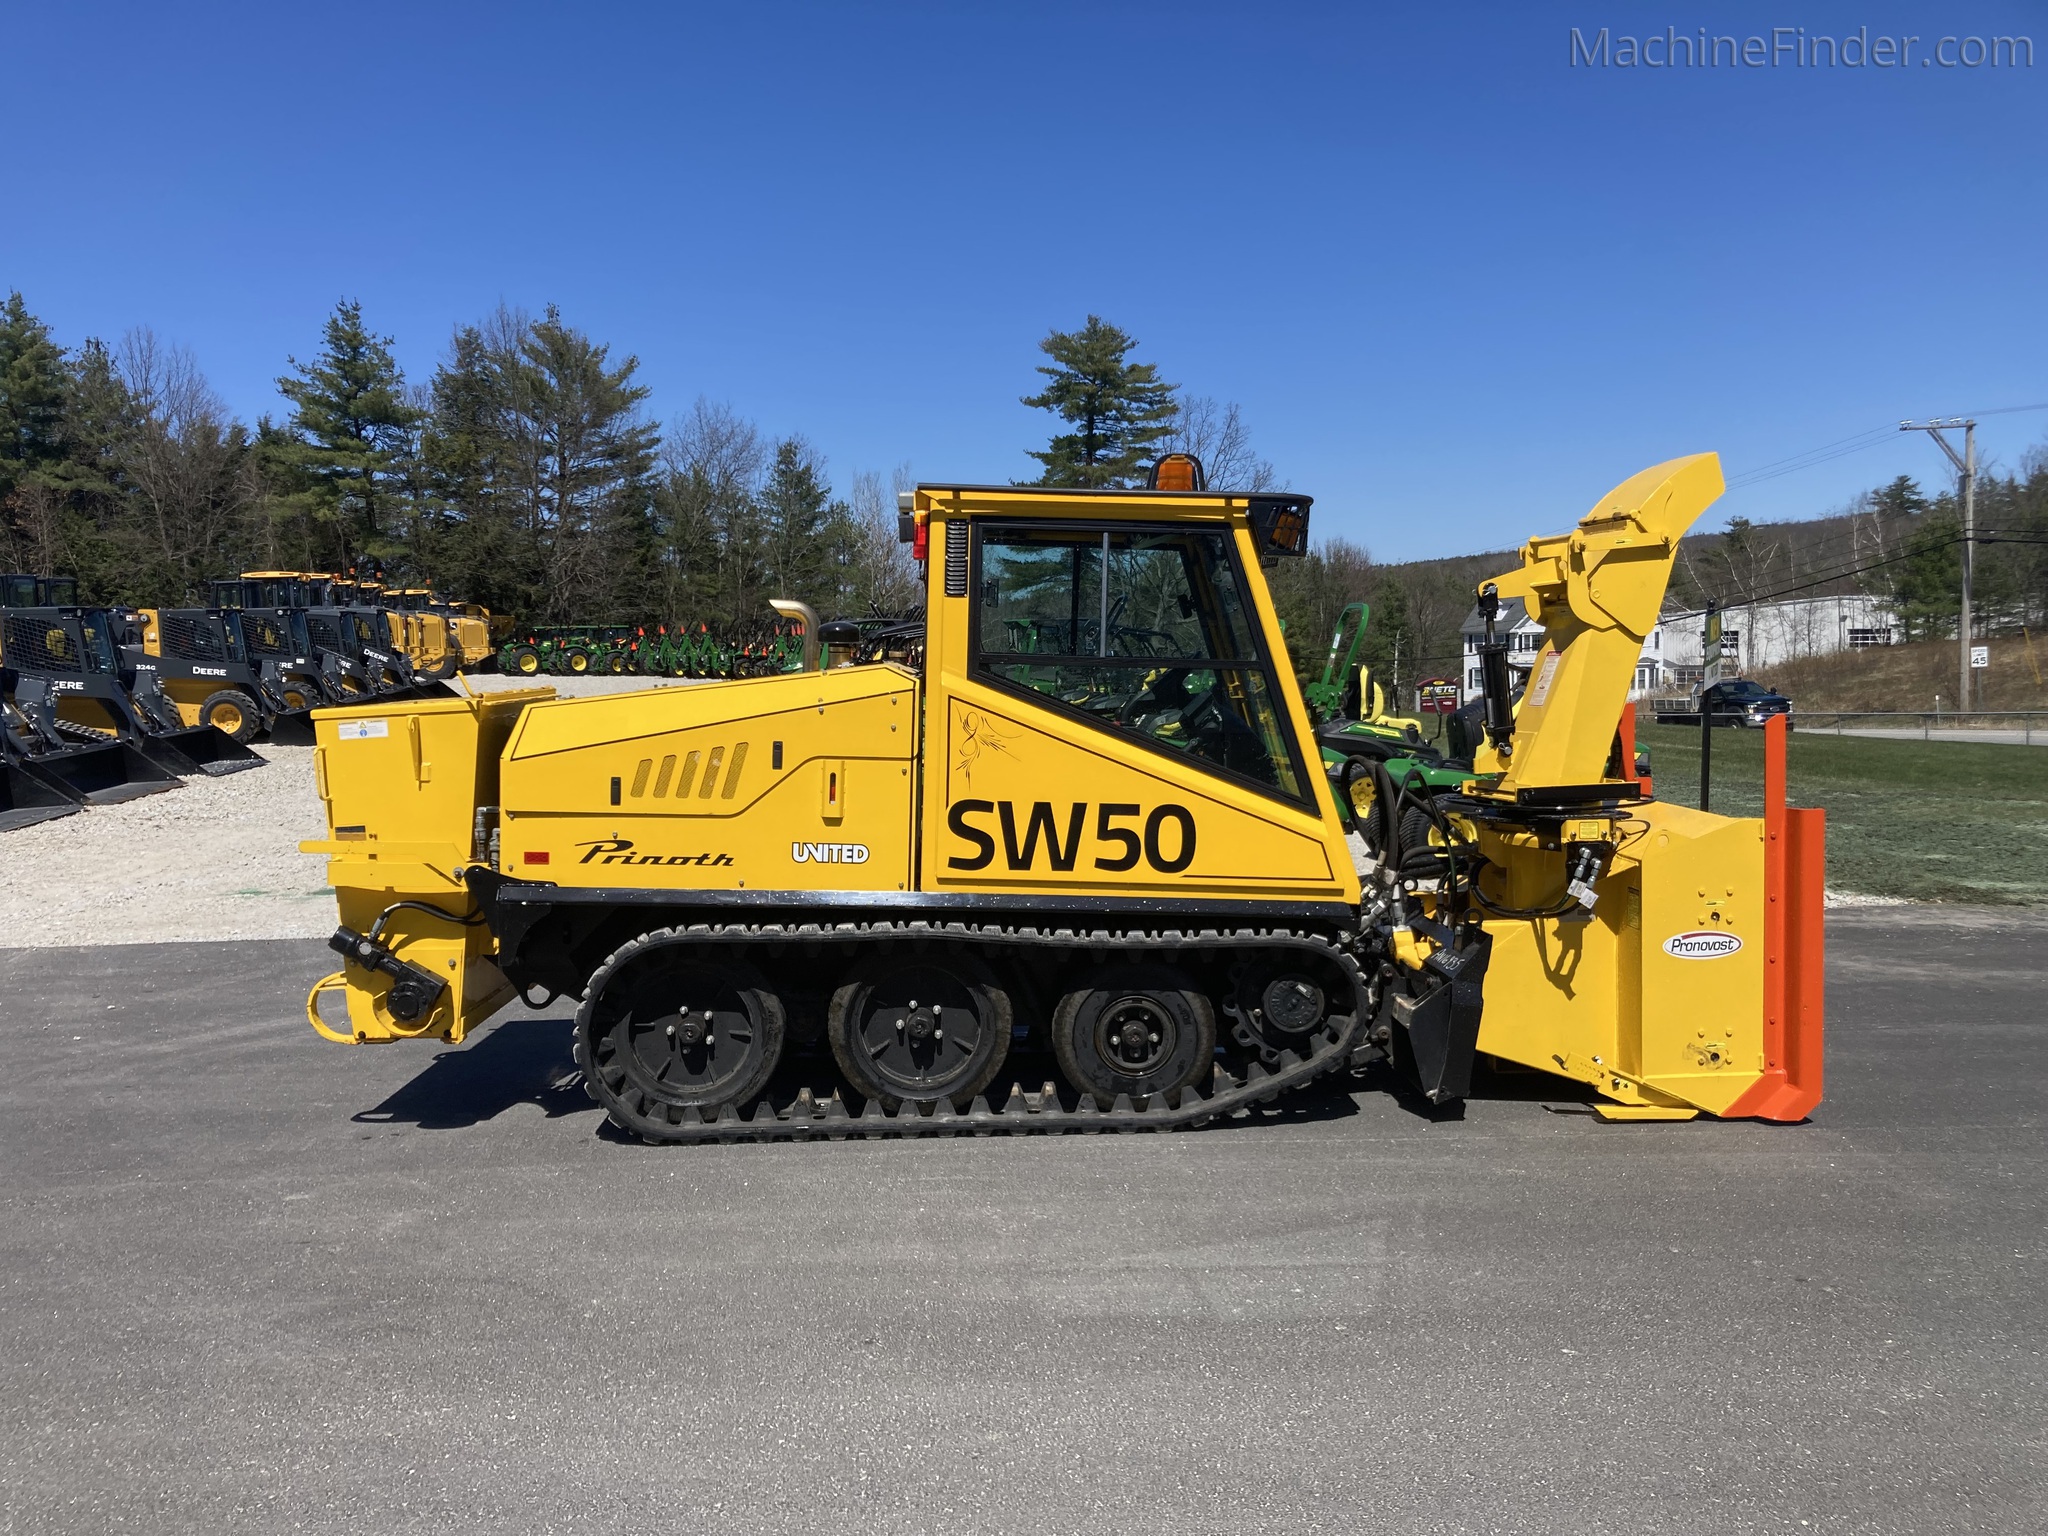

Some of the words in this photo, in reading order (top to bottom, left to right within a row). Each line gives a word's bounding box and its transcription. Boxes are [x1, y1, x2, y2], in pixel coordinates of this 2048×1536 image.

[363, 648, 389, 663] DEERE
[1972, 656, 1987, 665] 45
[192, 666, 227, 676] DEERE
[947, 799, 1197, 874] SW50
[575, 839, 734, 867] Prinoth
[792, 842, 870, 865] UNITED
[1671, 938, 1734, 952] Pronovost
